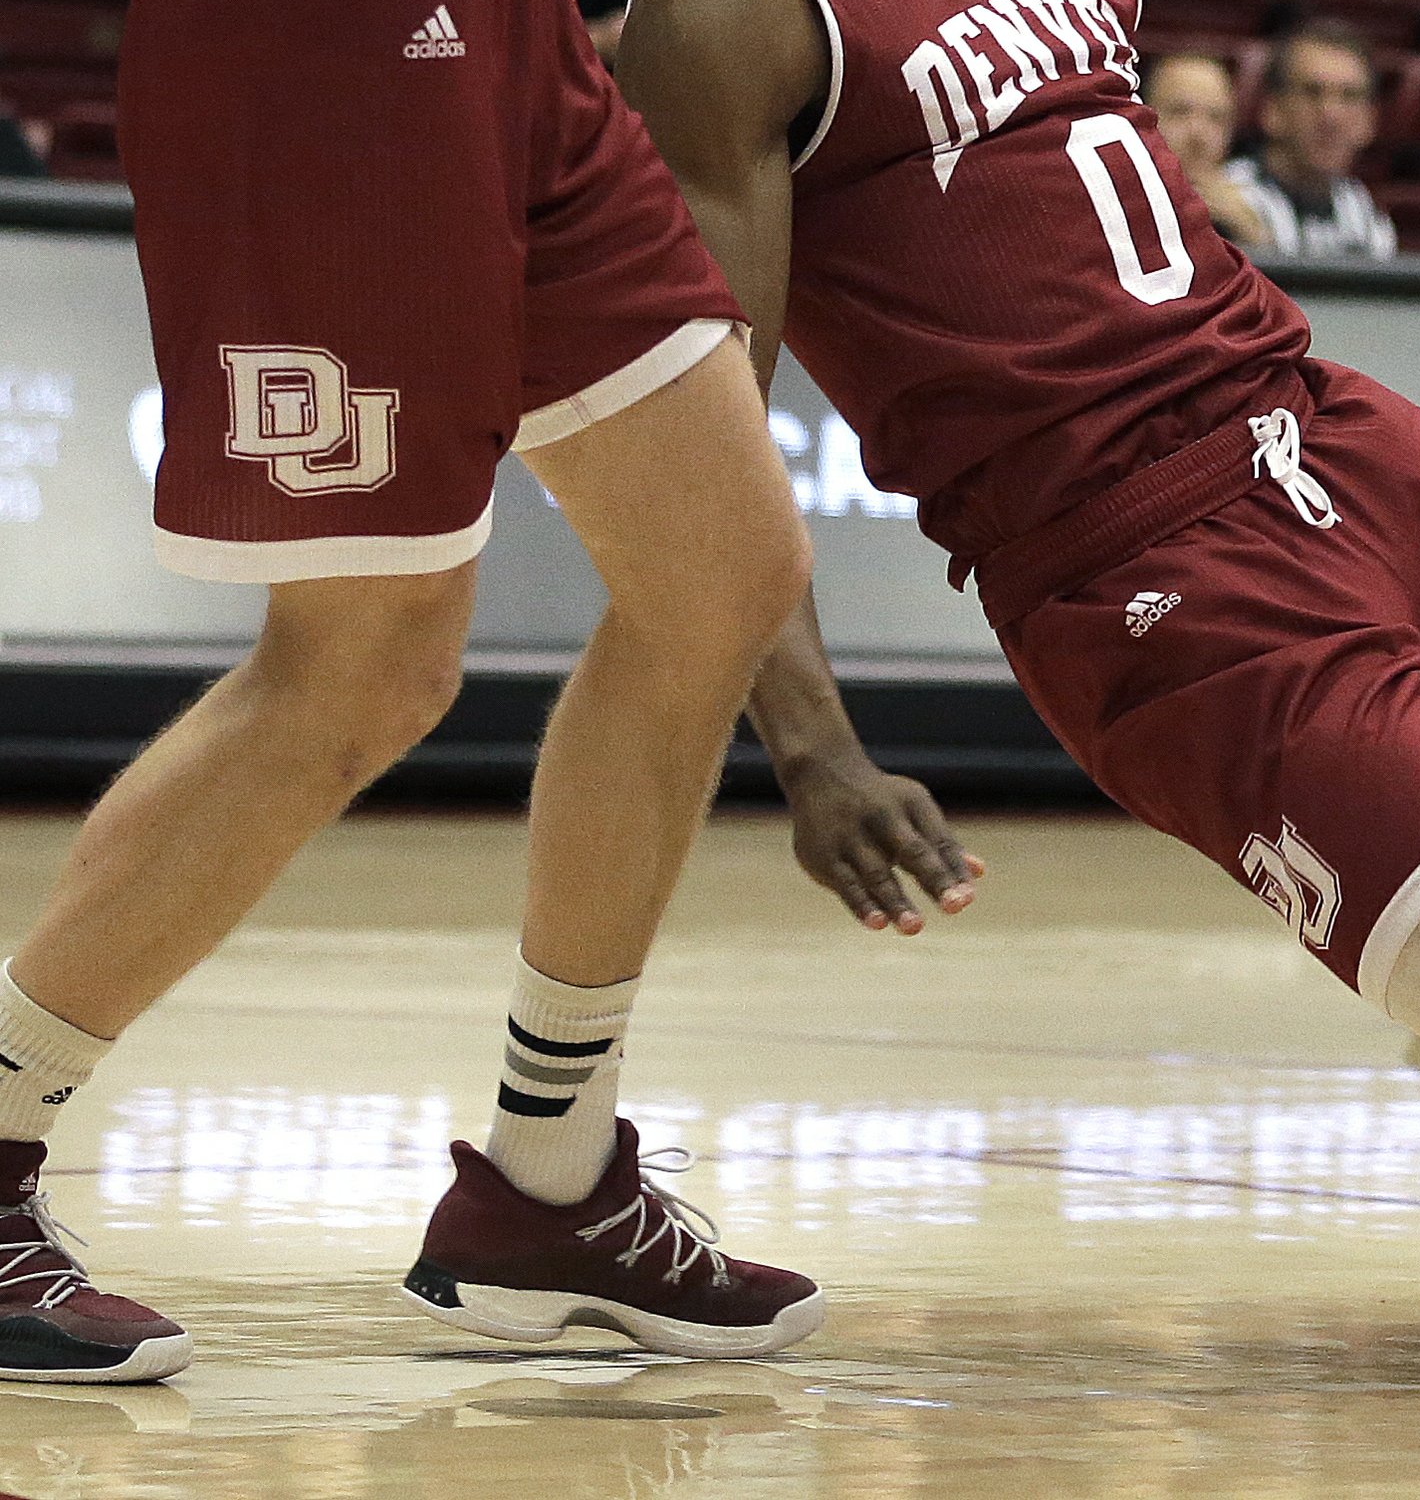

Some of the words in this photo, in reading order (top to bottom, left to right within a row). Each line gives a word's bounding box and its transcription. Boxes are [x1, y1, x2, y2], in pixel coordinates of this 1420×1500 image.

[402, 40, 466, 60] adidas
[1065, 113, 1195, 306] 0
[219, 344, 399, 497] DU
[1130, 592, 1182, 638] adidas
